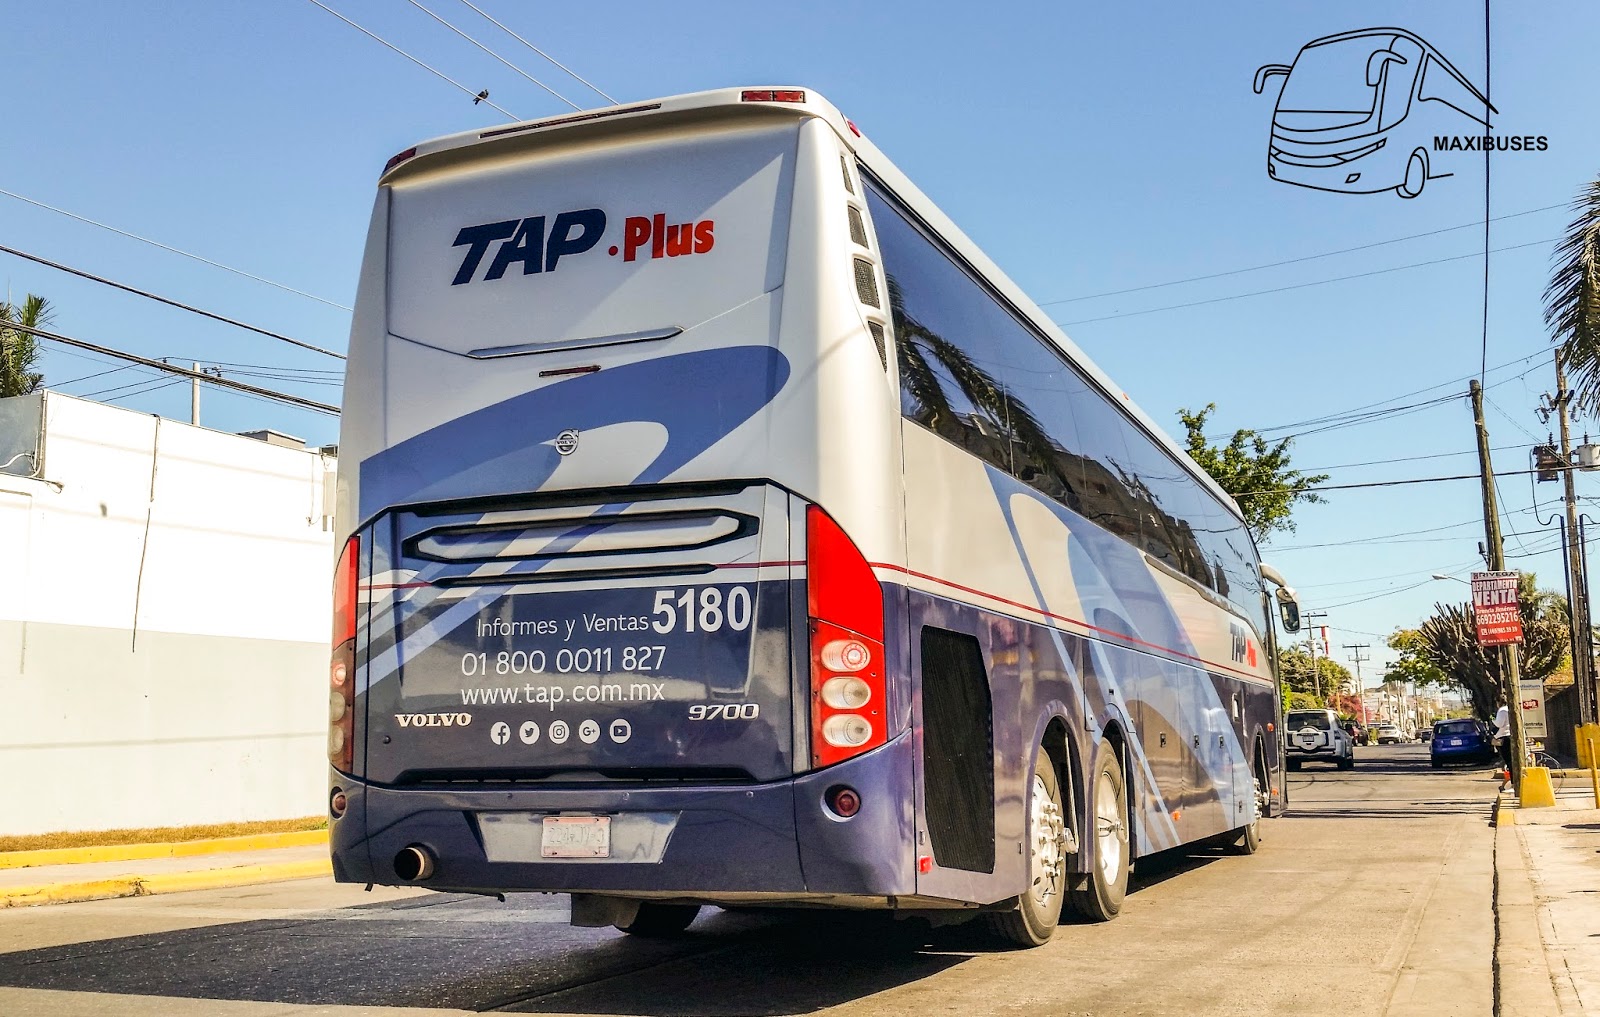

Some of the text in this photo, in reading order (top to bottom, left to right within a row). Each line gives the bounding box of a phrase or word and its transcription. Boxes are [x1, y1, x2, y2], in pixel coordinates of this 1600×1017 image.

[451, 208, 607, 286] TAP
[652, 585, 752, 634] 5180
[1472, 588, 1517, 607] VENTA
[476, 613, 649, 641] Informes y Ventas
[461, 645, 667, 676] 01 800 0011 827
[461, 682, 666, 711] www.tap.com.mx
[395, 712, 472, 728] VOLVO
[687, 703, 760, 721] 9700
